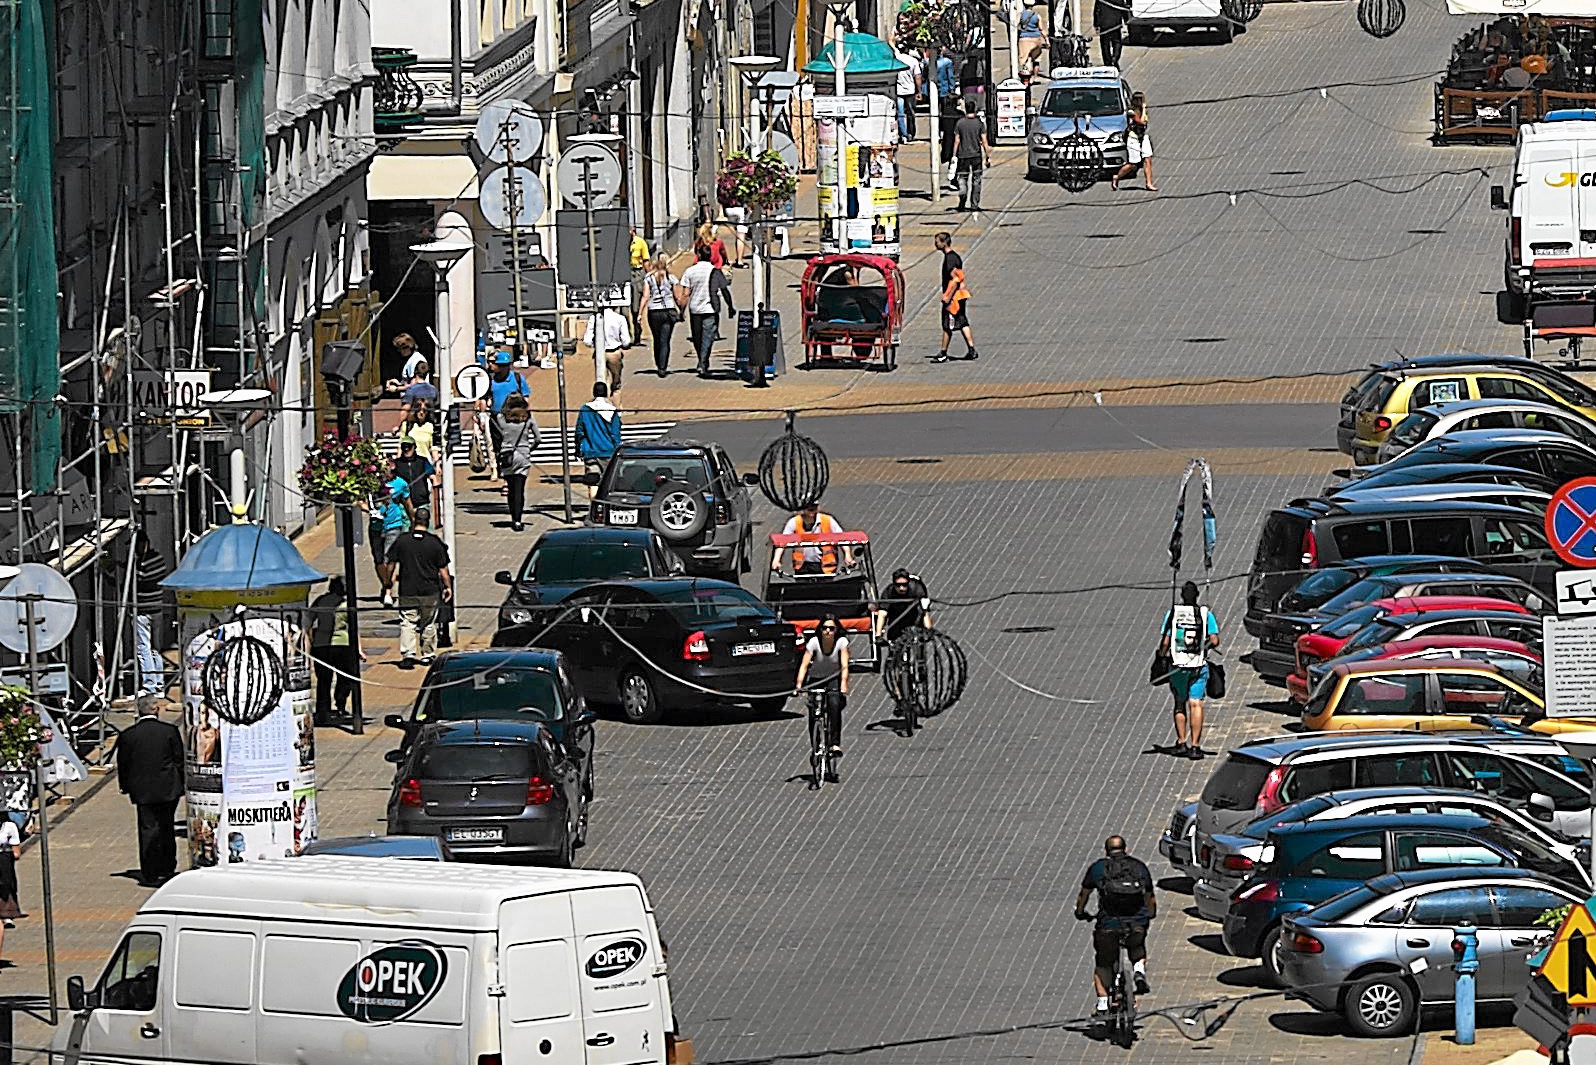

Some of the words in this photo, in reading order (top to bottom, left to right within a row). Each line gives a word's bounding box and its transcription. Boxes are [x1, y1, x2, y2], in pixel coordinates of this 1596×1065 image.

[132, 381, 206, 408] KANTOR
[594, 946, 637, 966] OPEK
[359, 958, 426, 996] OPEK
